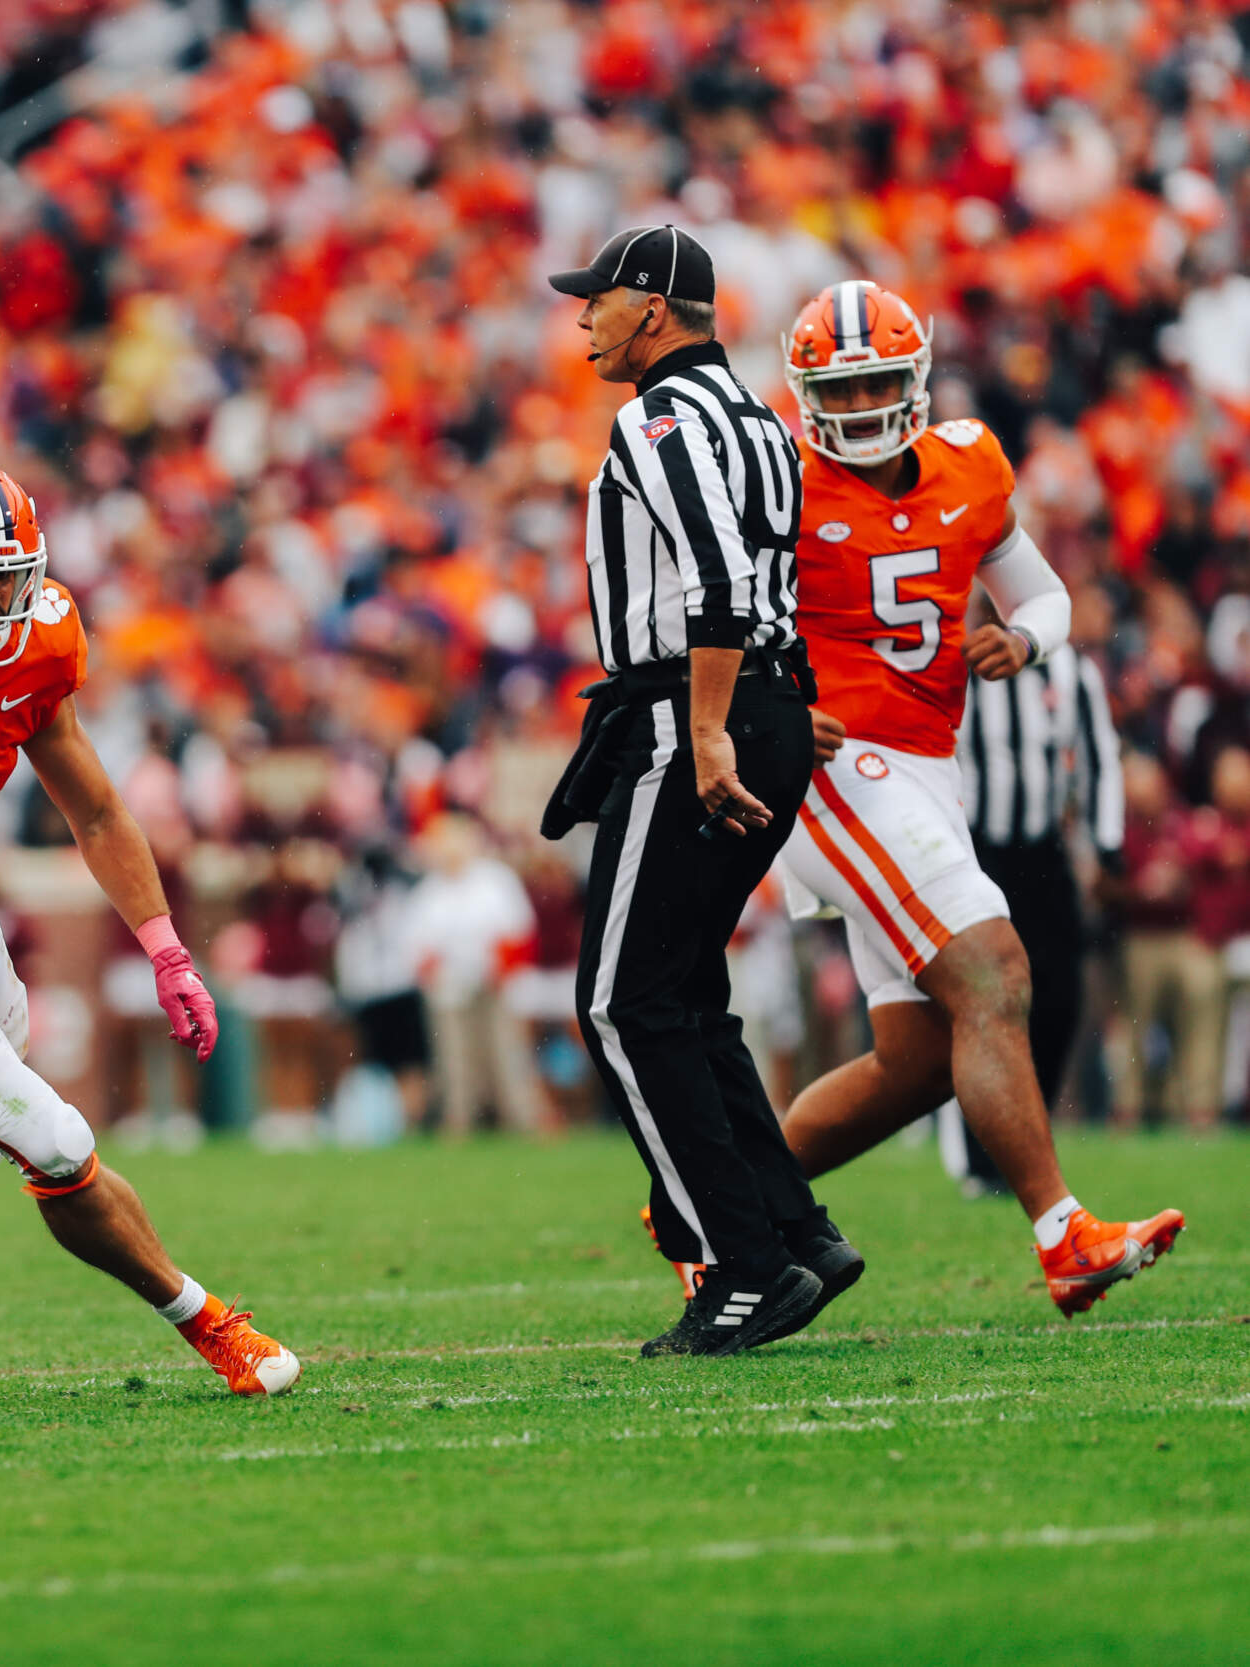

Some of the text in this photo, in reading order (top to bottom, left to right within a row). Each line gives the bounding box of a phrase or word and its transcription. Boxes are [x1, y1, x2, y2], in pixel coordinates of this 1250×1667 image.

[636, 272, 649, 285] S
[740, 416, 794, 537] U
[869, 546, 942, 672] 5
